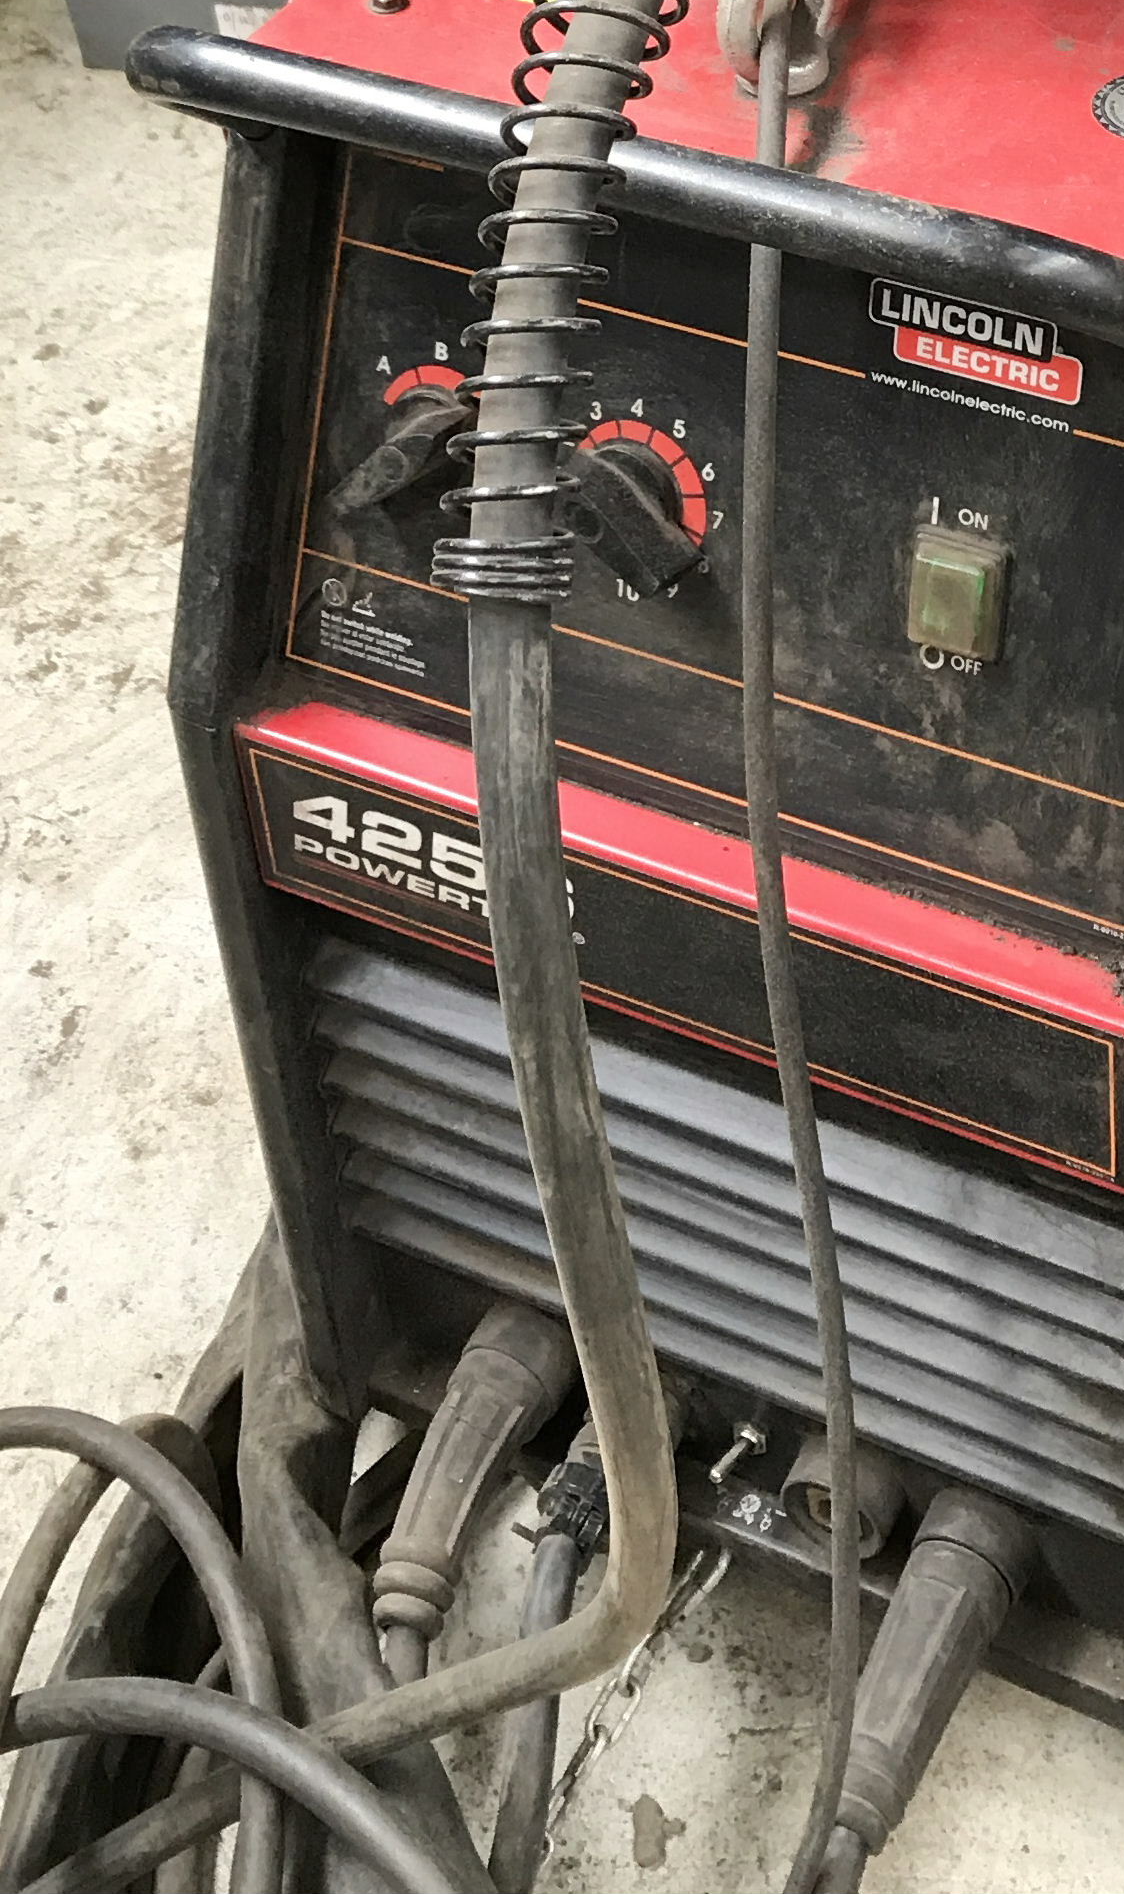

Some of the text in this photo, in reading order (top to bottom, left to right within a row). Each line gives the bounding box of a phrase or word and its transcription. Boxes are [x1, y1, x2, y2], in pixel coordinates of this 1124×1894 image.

[881, 288, 1045, 356] LINCOLN
[375, 341, 449, 375] A B
[916, 336, 1061, 393] ELECTRIC
[870, 370, 1070, 433] www.lincolnelectric.com
[589, 400, 602, 421] 3
[630, 398, 644, 418] 4
[672, 418, 686, 439] 5
[701, 462, 716, 482] 6
[711, 509, 725, 530] 7
[957, 508, 989, 531] ON
[950, 655, 983, 676] OFF
